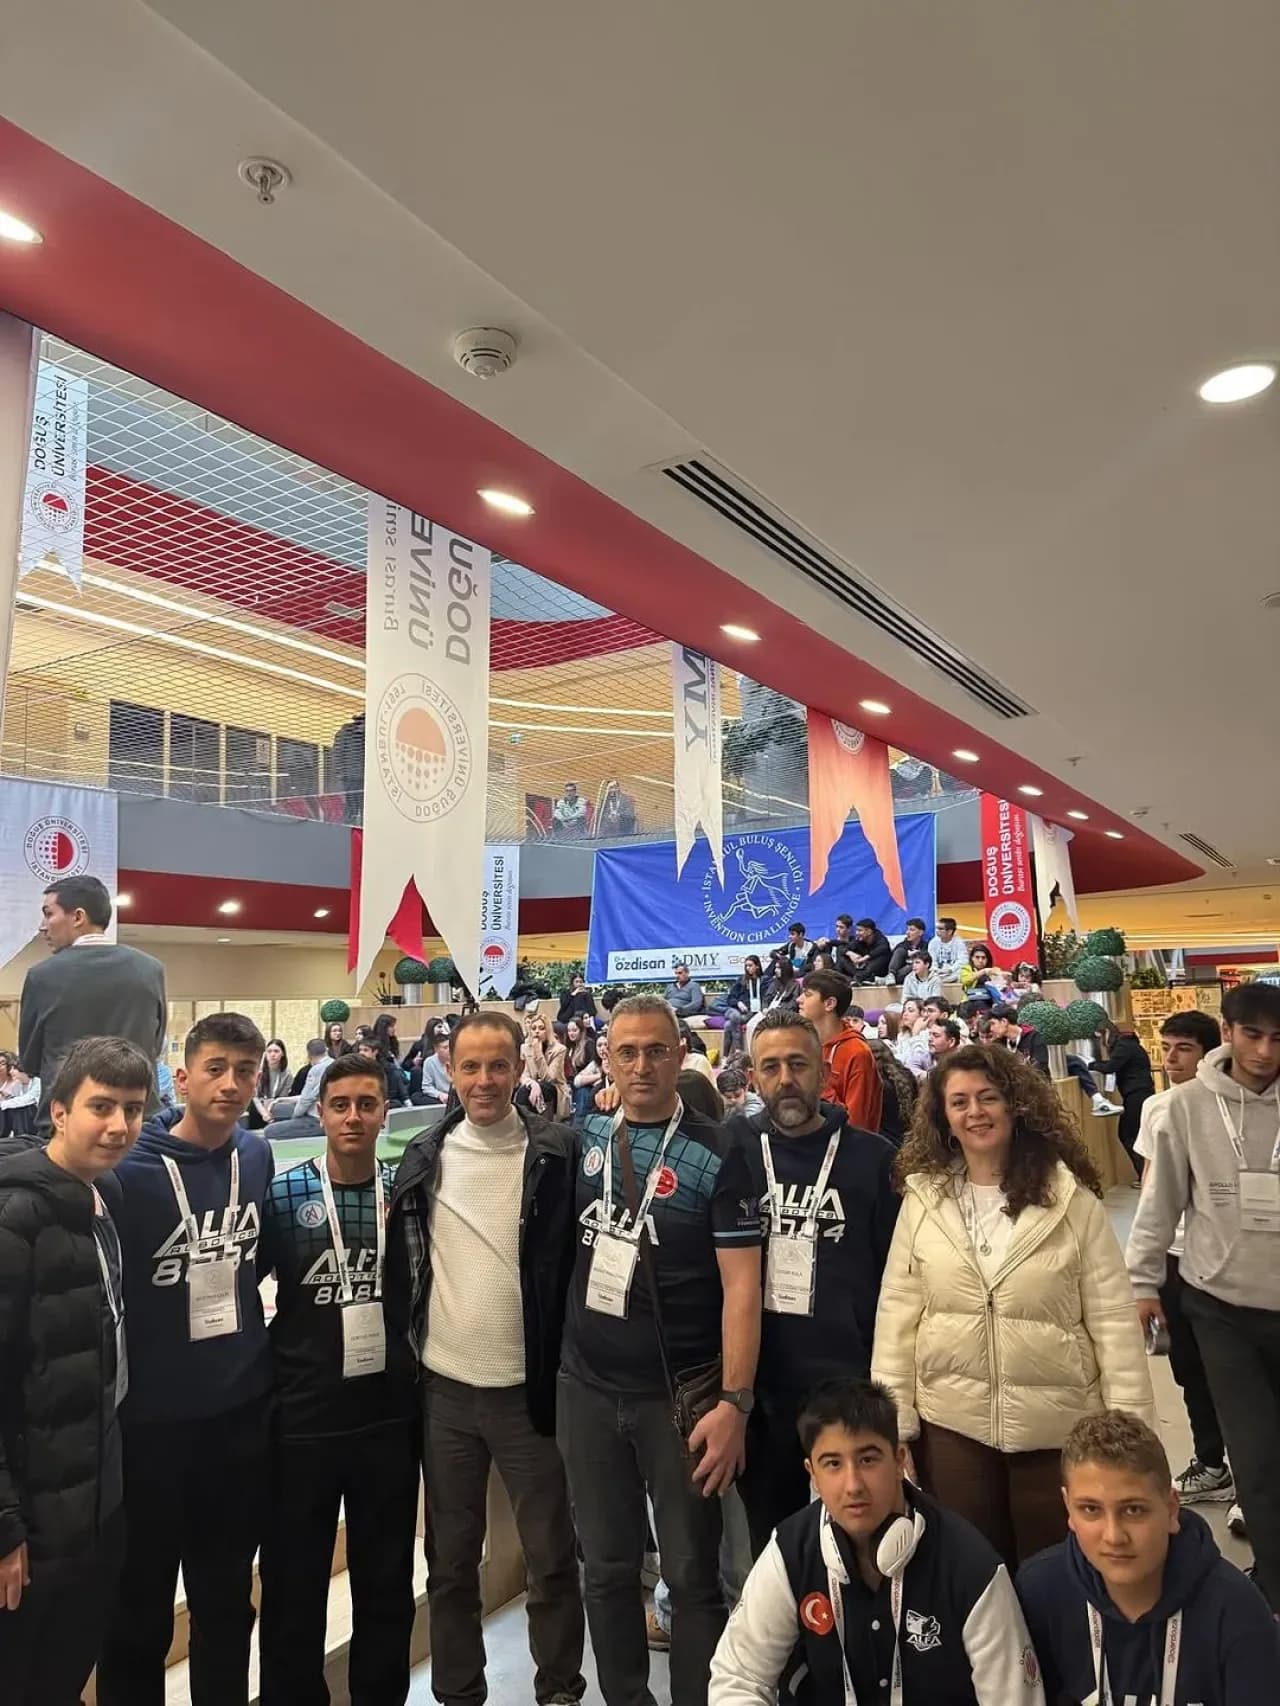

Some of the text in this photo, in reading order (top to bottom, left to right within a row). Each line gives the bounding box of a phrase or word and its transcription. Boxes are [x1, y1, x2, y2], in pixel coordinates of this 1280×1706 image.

[702, 834, 805, 890] İSTAUL BULUŞ ŞENLİĞİ
[986, 846, 999, 897] DOĞUŞ
[490, 856, 504, 931] ÜNİVERSİTESİ
[703, 892, 801, 943] INVENTION CHALLENGE
